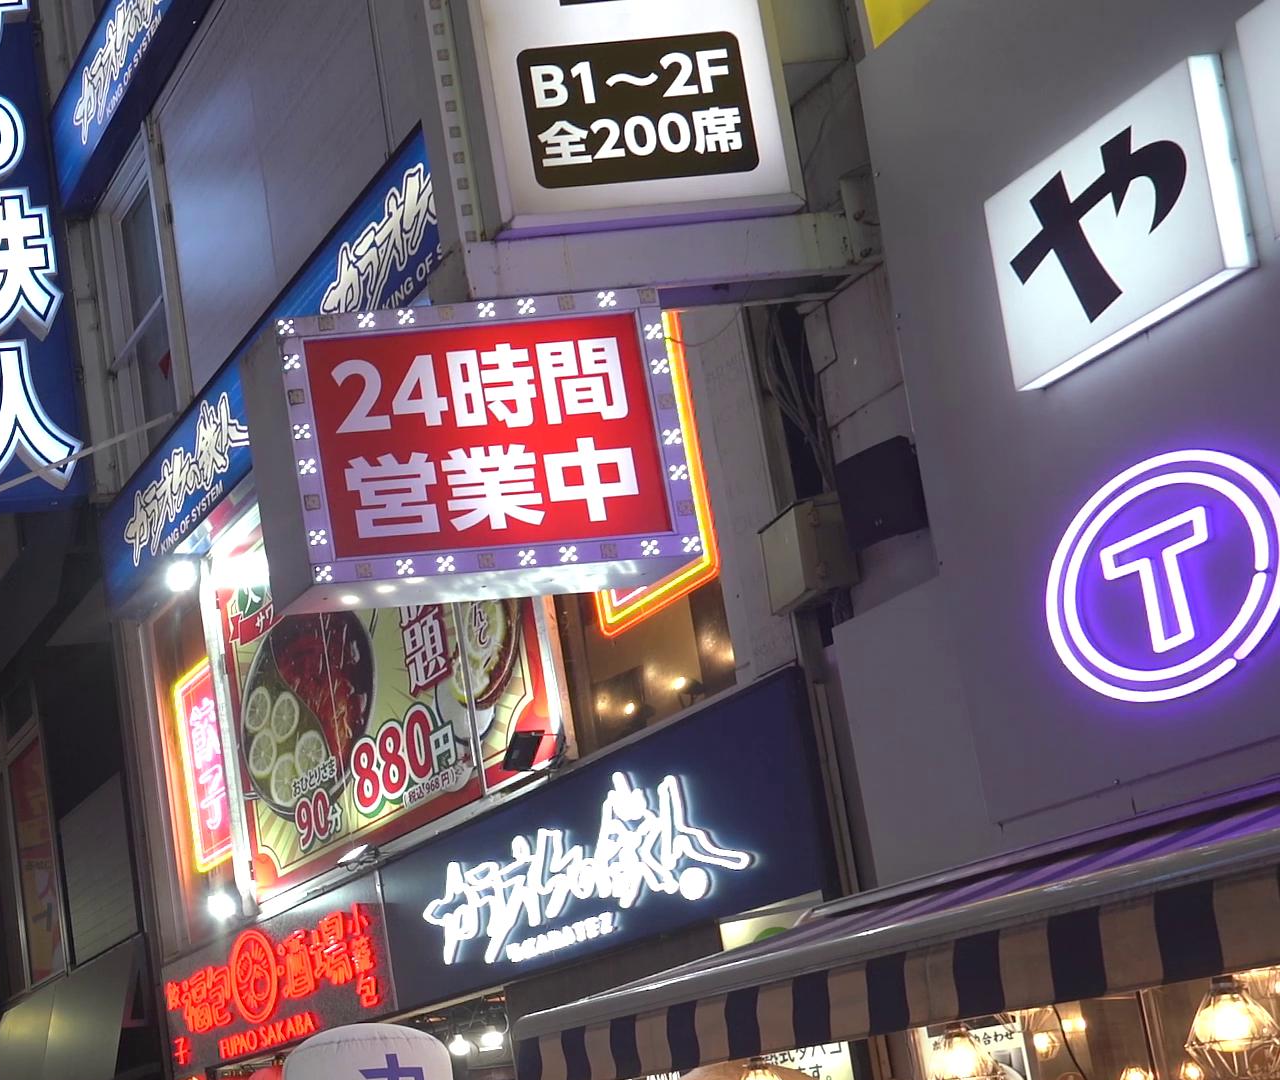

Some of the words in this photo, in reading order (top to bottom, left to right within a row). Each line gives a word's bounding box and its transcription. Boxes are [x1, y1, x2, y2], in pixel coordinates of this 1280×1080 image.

[106, 84, 124, 119] KING
[123, 67, 133, 87] OF
[133, 11, 162, 67] SYSTEM
[538, 106, 743, 168] 全200席
[1009, 125, 1188, 324] や
[331, 335, 630, 435] 24時間
[124, 392, 250, 567] カラオケの鉄人
[160, 530, 180, 556] KING
[179, 518, 191, 535] OF
[190, 480, 224, 522] SYSTEM
[345, 437, 640, 540] 営業中
[1100, 506, 1208, 653] T
[290, 757, 337, 798] おひとりさま
[351, 703, 456, 815] 880円
[294, 788, 342, 852] 90分
[219, 1027, 259, 1059] FUPAO
[259, 1011, 317, 1051] SAKABA
